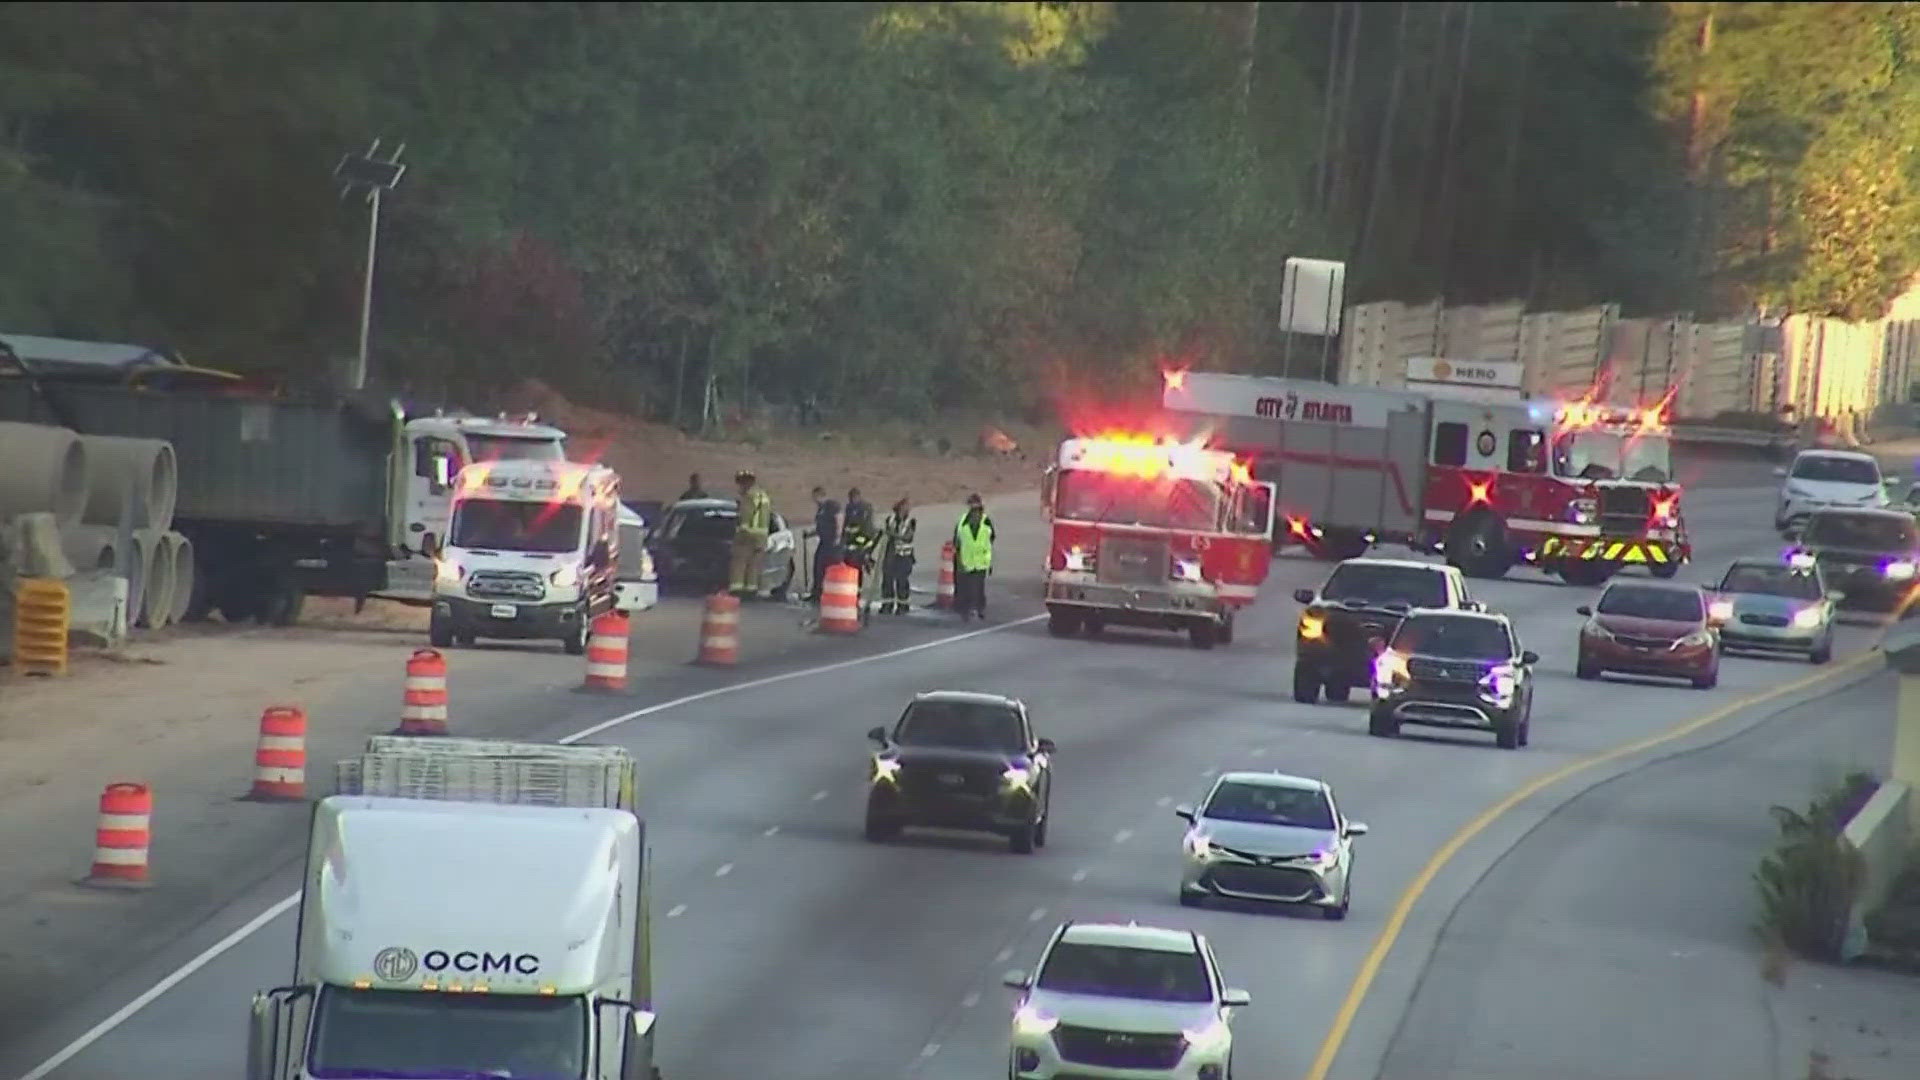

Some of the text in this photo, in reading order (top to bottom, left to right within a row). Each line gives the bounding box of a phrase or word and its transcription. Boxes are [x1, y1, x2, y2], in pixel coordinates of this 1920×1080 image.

[1255, 397, 1282, 419] CITY
[1302, 401, 1352, 423] ATLANTA
[425, 950, 539, 975] OCMC
